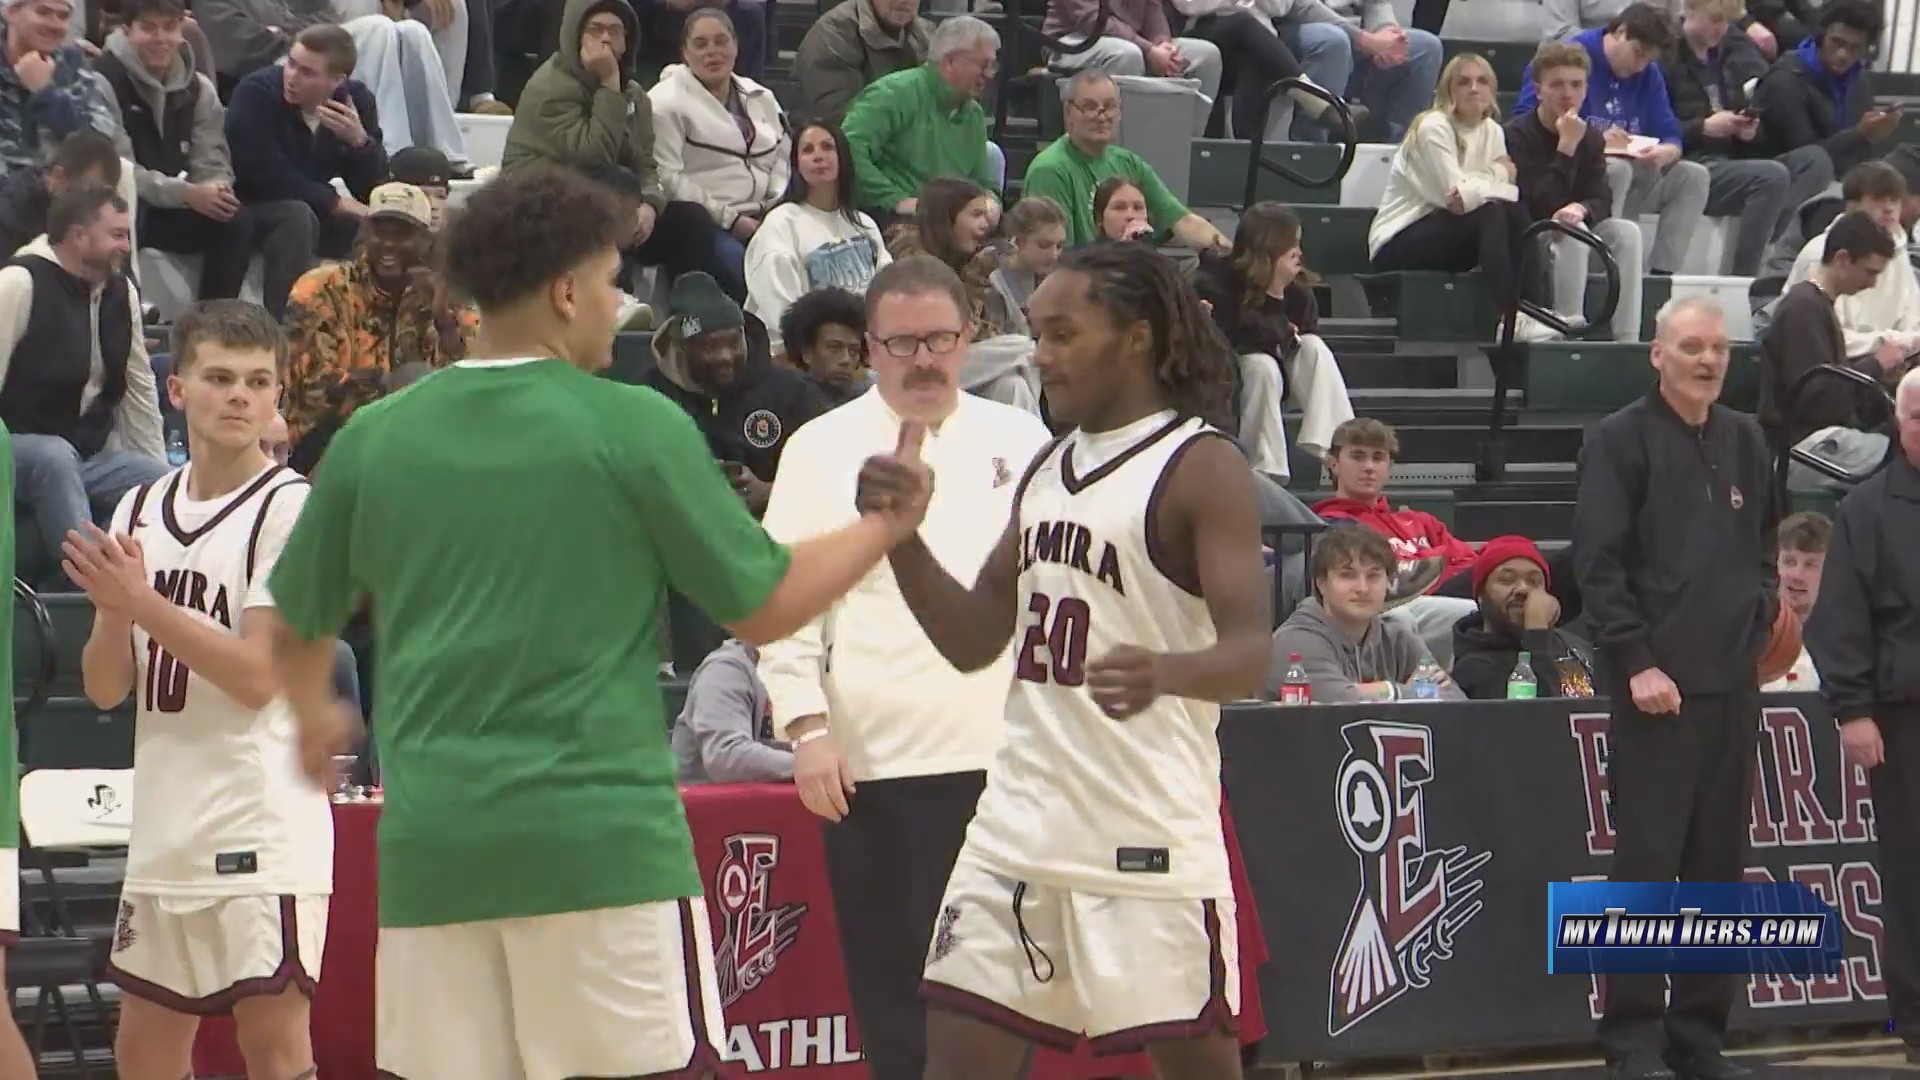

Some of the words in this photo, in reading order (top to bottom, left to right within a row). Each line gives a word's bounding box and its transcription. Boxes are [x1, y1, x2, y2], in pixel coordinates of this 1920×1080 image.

[146, 636, 190, 713] 10
[1016, 591, 1091, 687] 20
[717, 1013, 868, 1073] ATHL
